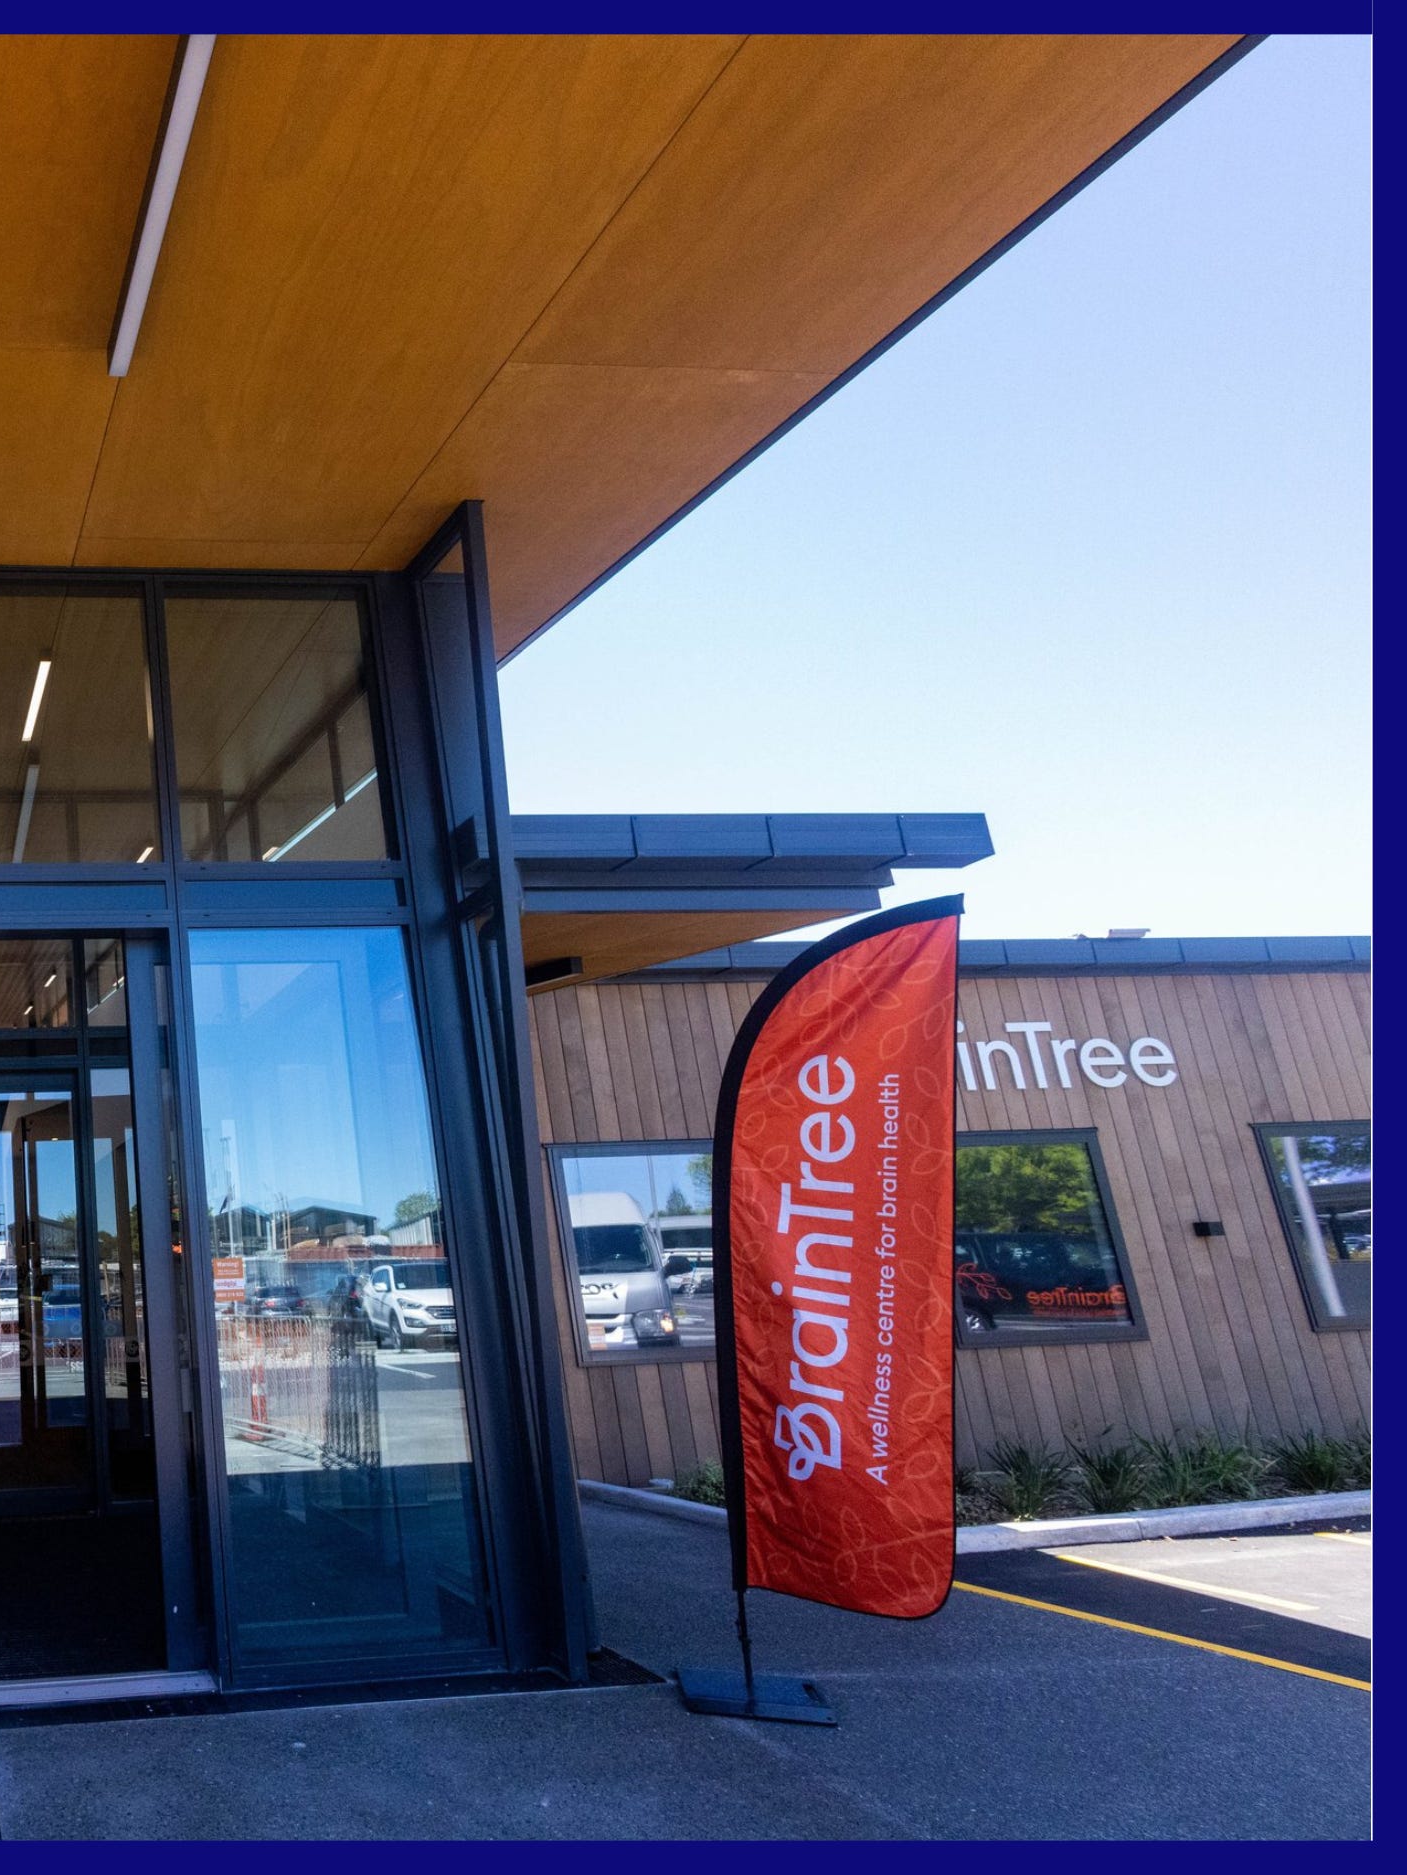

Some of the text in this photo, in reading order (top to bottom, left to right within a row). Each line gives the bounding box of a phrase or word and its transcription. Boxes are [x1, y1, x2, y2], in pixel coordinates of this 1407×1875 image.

[957, 1021, 1176, 1091] inTree
[772, 1054, 857, 1482] BrainTree
[865, 1073, 900, 1485] A wellness centre for brain health
